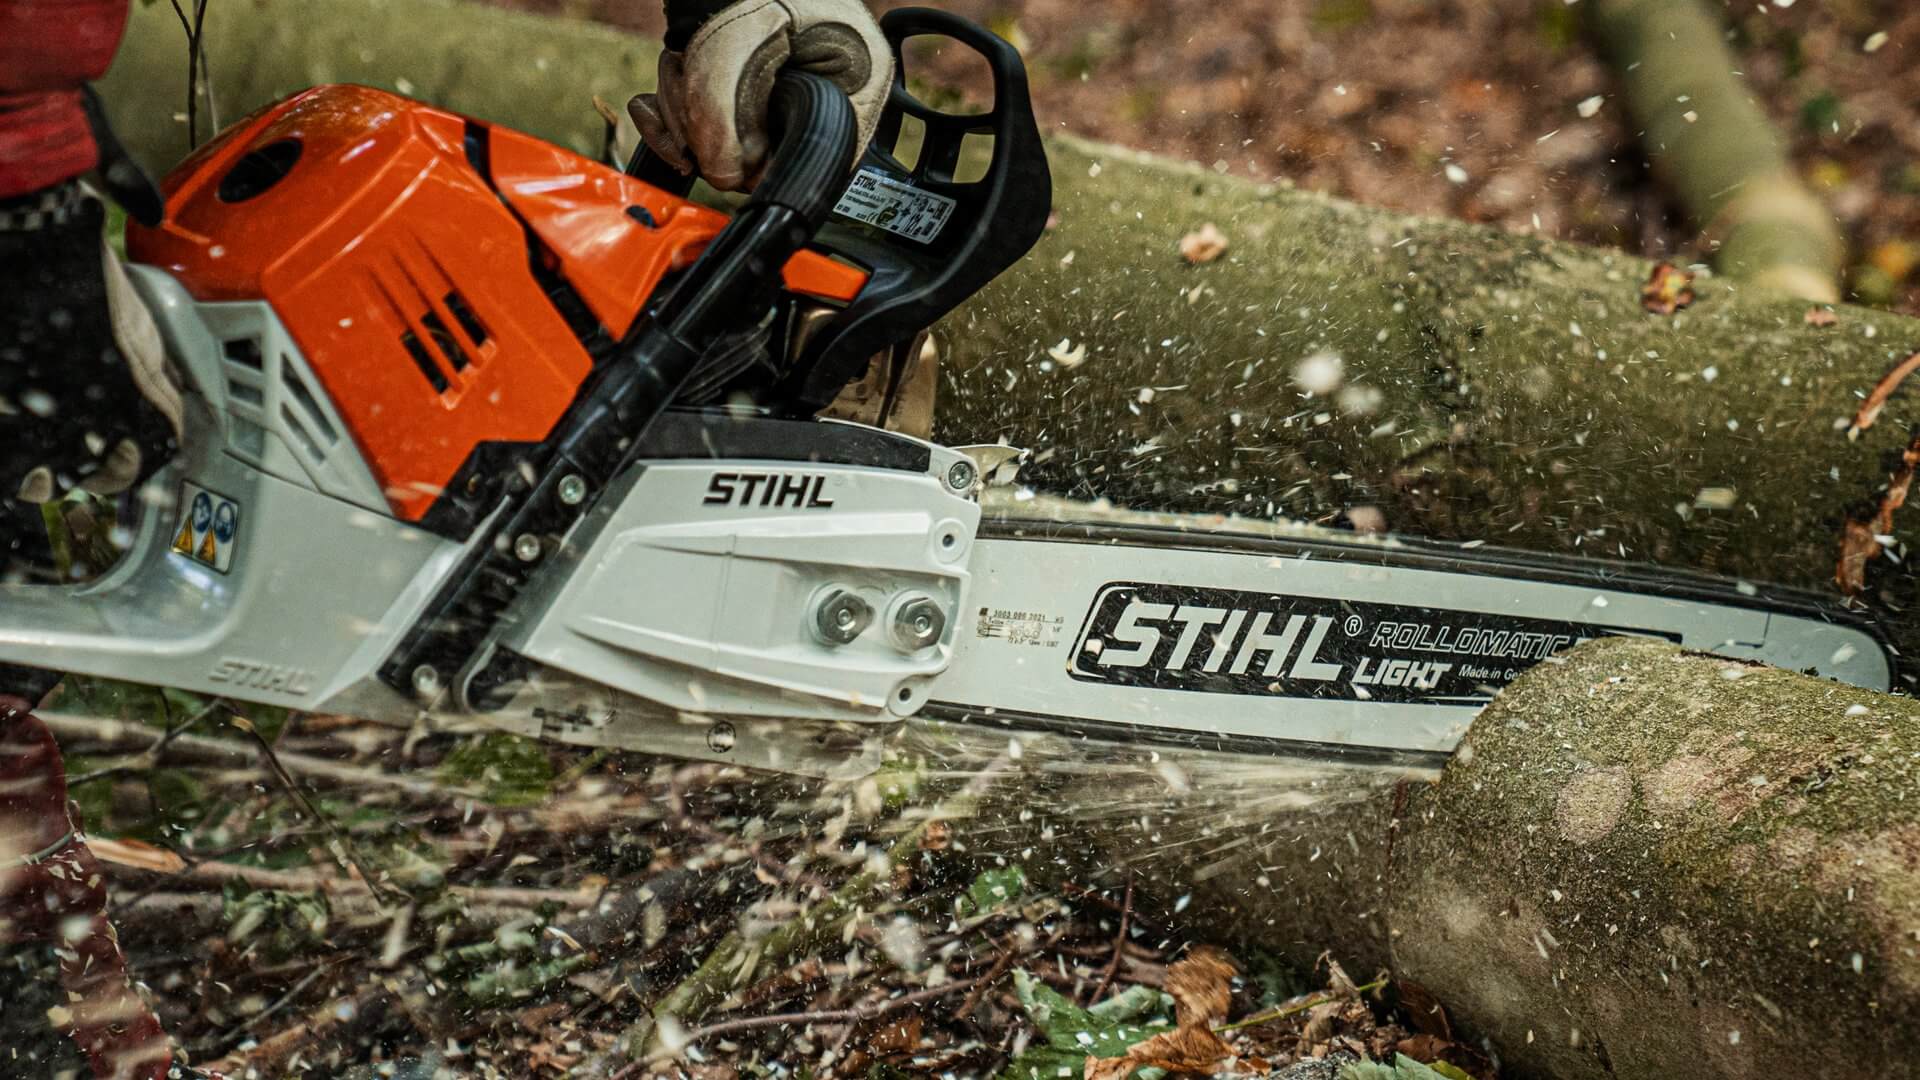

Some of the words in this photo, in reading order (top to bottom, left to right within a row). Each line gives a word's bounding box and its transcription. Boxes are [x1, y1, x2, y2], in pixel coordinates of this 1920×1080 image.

[854, 175, 877, 191] STIHL
[702, 472, 834, 508] STIHL
[1097, 601, 1343, 681] STIHL
[1369, 621, 1570, 660] ROLLOMATIC
[207, 656, 311, 697] STIHL
[1351, 656, 1453, 689] LIGHT
[1458, 664, 1489, 680] Made
[1490, 667, 1500, 680] in
